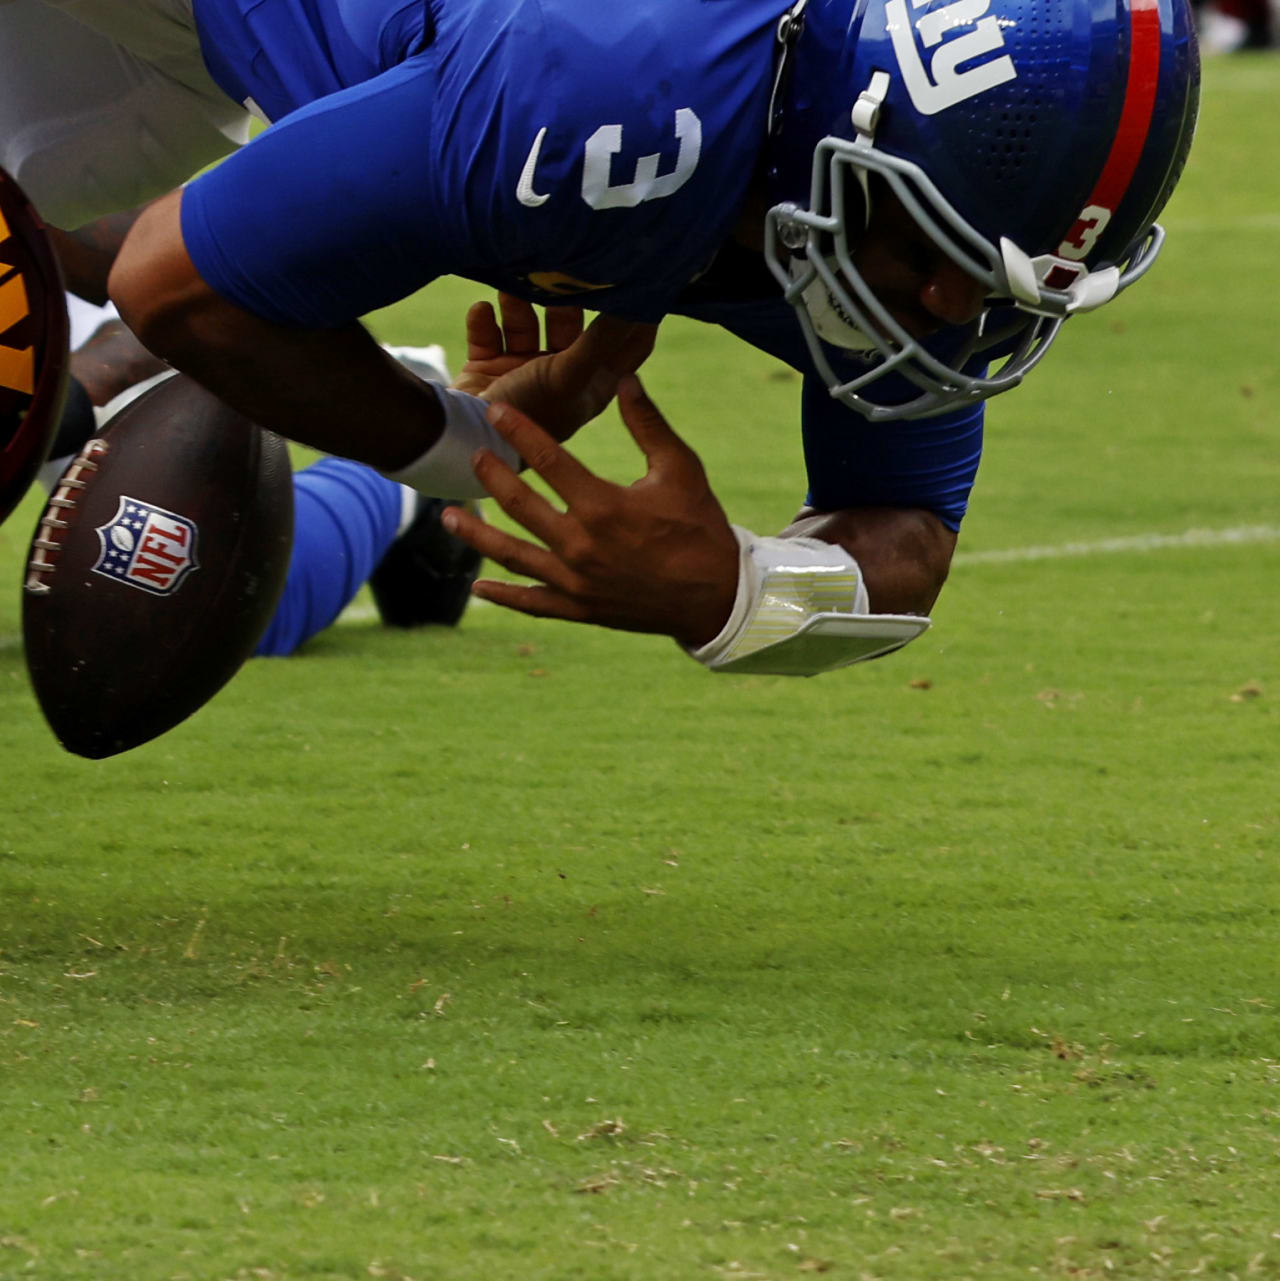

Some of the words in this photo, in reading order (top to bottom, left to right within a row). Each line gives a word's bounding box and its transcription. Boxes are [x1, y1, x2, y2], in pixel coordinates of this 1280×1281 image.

[582, 107, 702, 211] 3
[1058, 205, 1111, 261] 3
[130, 523, 188, 587] NFL
